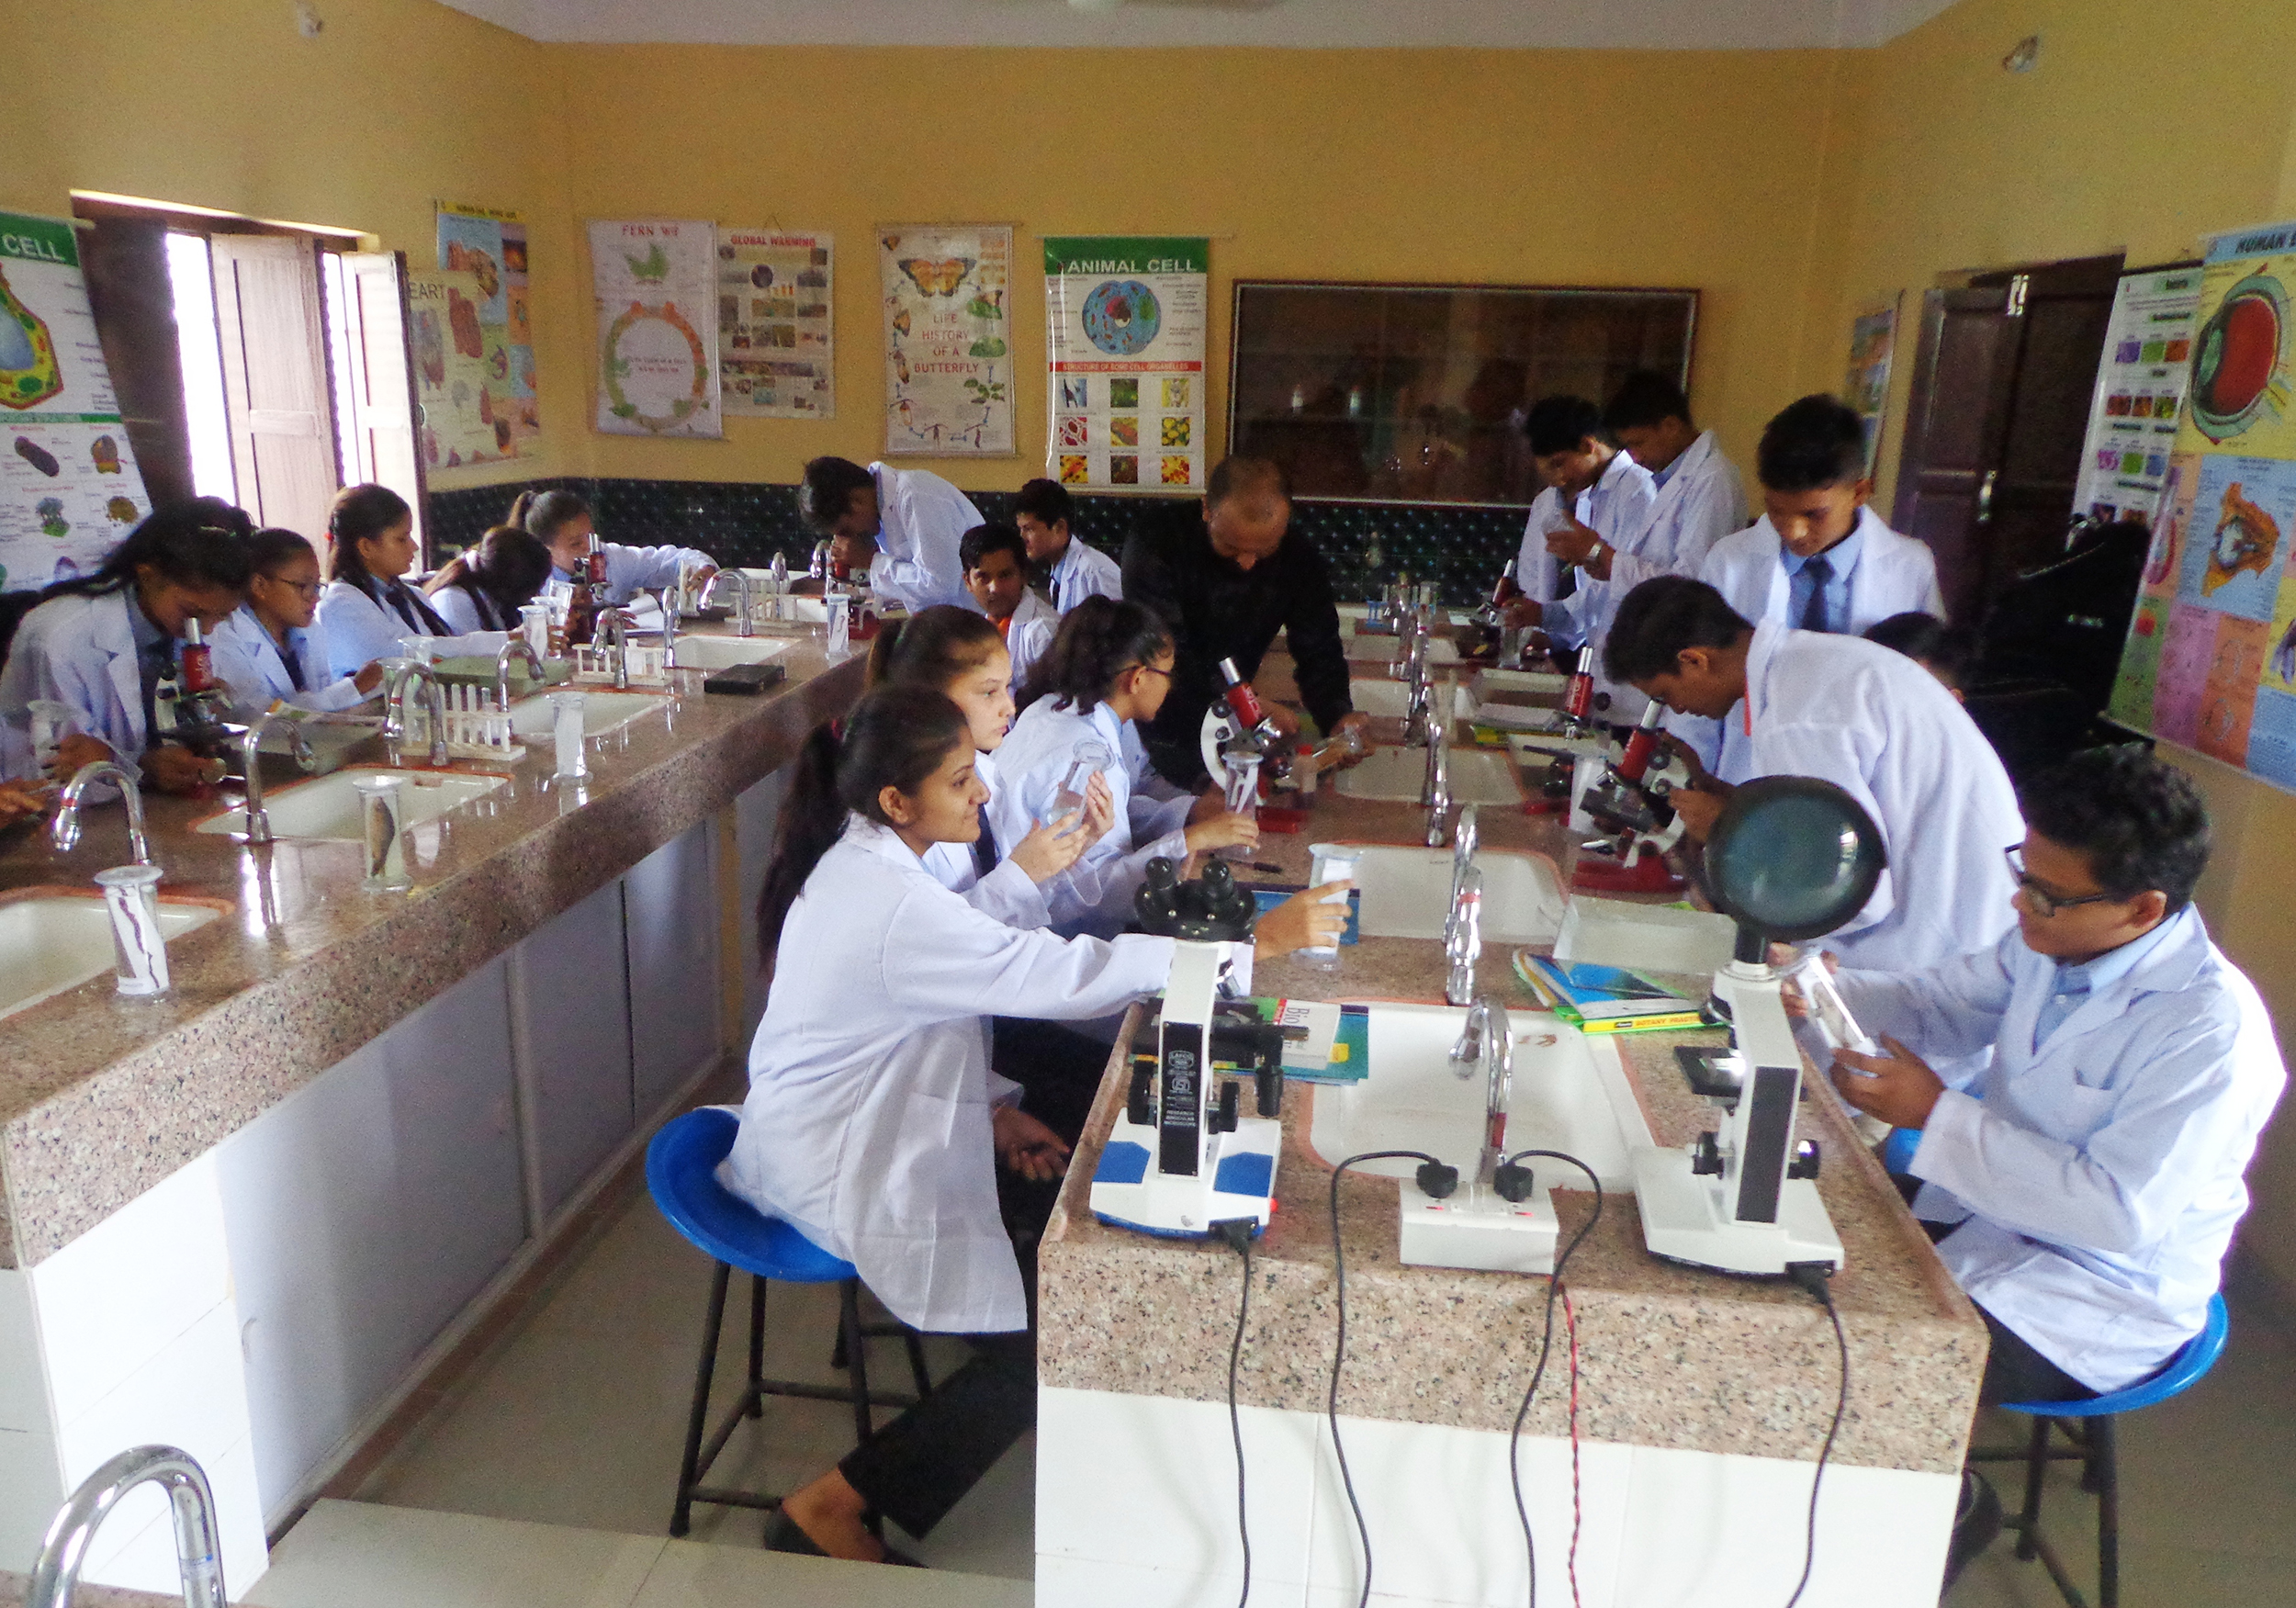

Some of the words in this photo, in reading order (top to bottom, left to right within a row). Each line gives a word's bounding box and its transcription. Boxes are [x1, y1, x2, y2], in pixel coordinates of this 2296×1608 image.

[2, 232, 66, 261] CELL
[731, 235, 767, 245] GLOBAL
[771, 236, 816, 247] WARMING
[1067, 259, 1142, 274] ANIMAL
[1147, 258, 1198, 273] CELL
[409, 281, 445, 300] EART
[933, 313, 958, 323] LIFE
[922, 330, 969, 340] HISTORY
[933, 345, 948, 356] OF
[952, 346, 960, 356] A
[914, 362, 979, 373] BUTTERFLY
